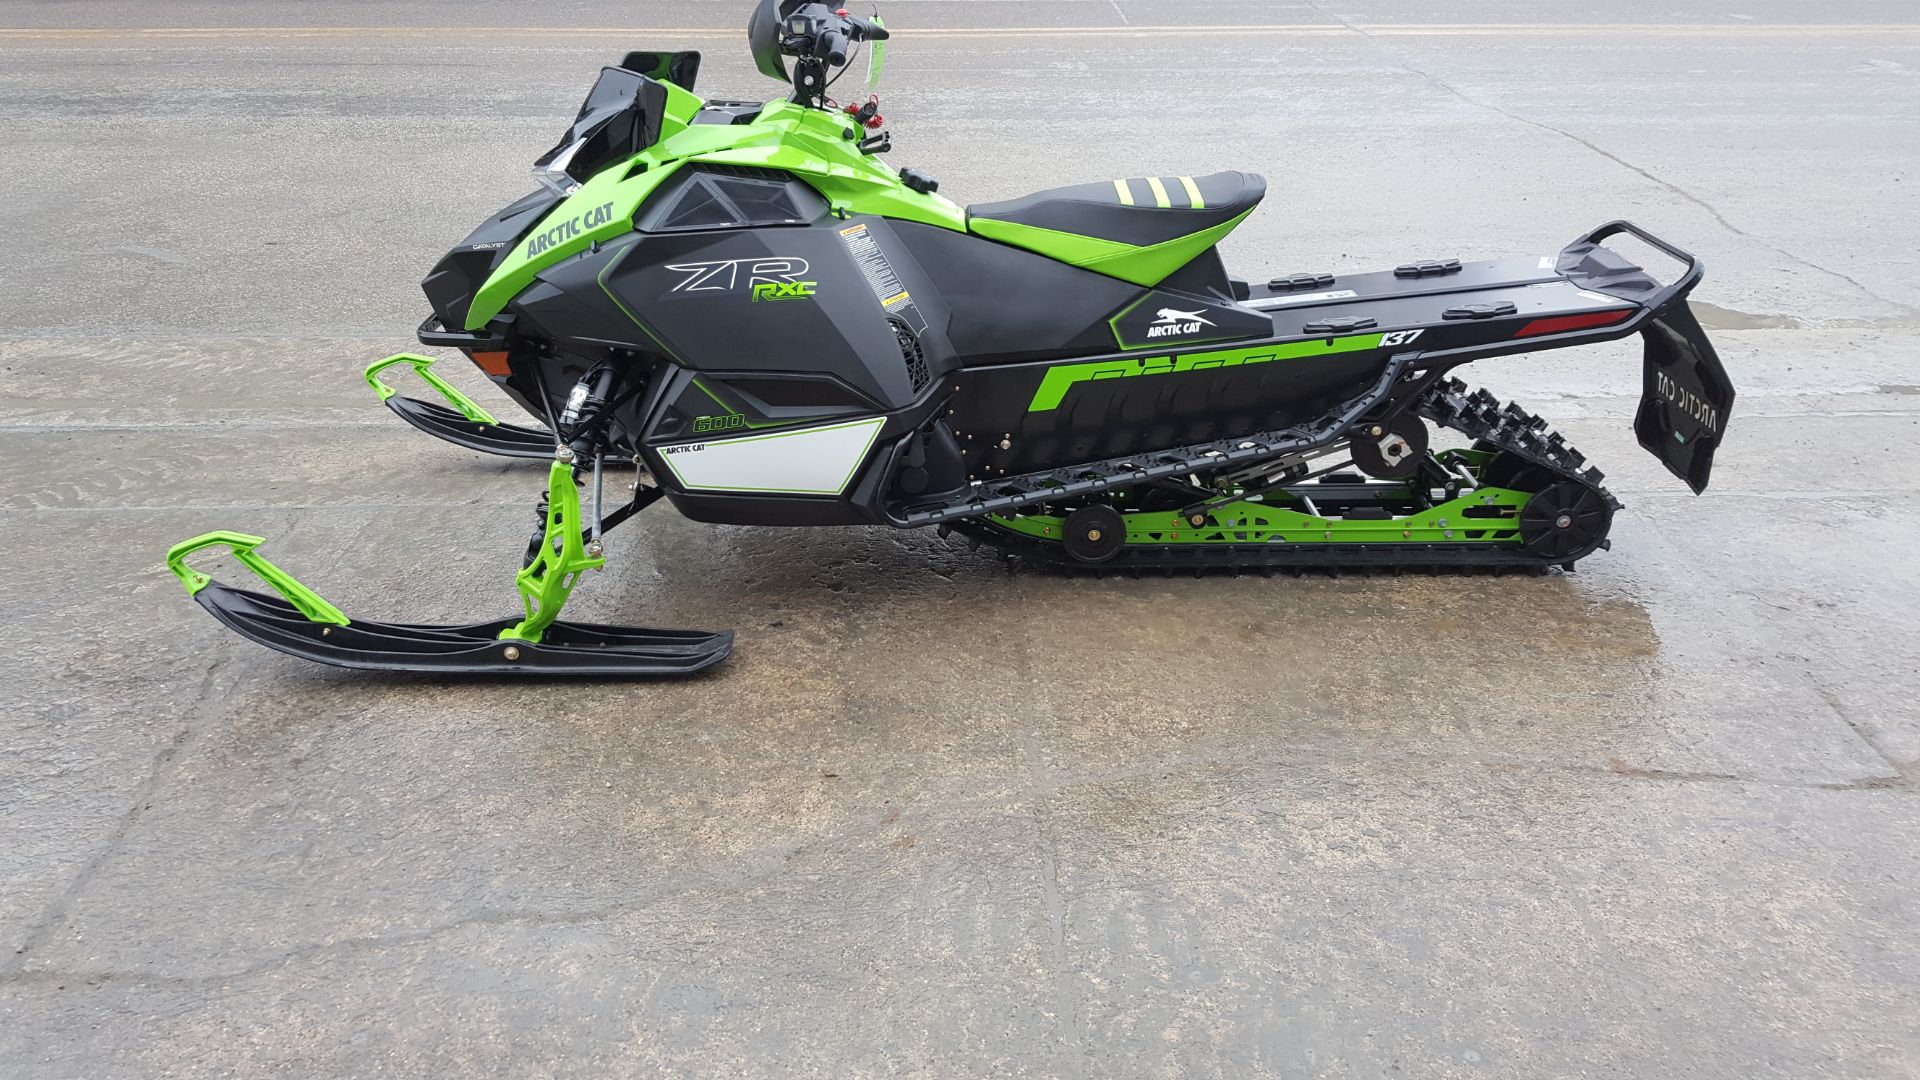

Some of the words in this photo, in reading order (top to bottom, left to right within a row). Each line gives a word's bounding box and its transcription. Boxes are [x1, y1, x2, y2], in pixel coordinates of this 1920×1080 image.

[526, 215, 581, 260] ARCTIC
[583, 201, 614, 230] CAT
[472, 242, 506, 250] CATALYST
[751, 281, 818, 302] RXC
[1147, 324, 1182, 338] ARCTIC
[1183, 322, 1202, 334] CAT
[1378, 329, 1426, 347] 137
[693, 413, 746, 432] 600
[666, 445, 691, 454] ARCTIC
[692, 443, 706, 452] CAT
